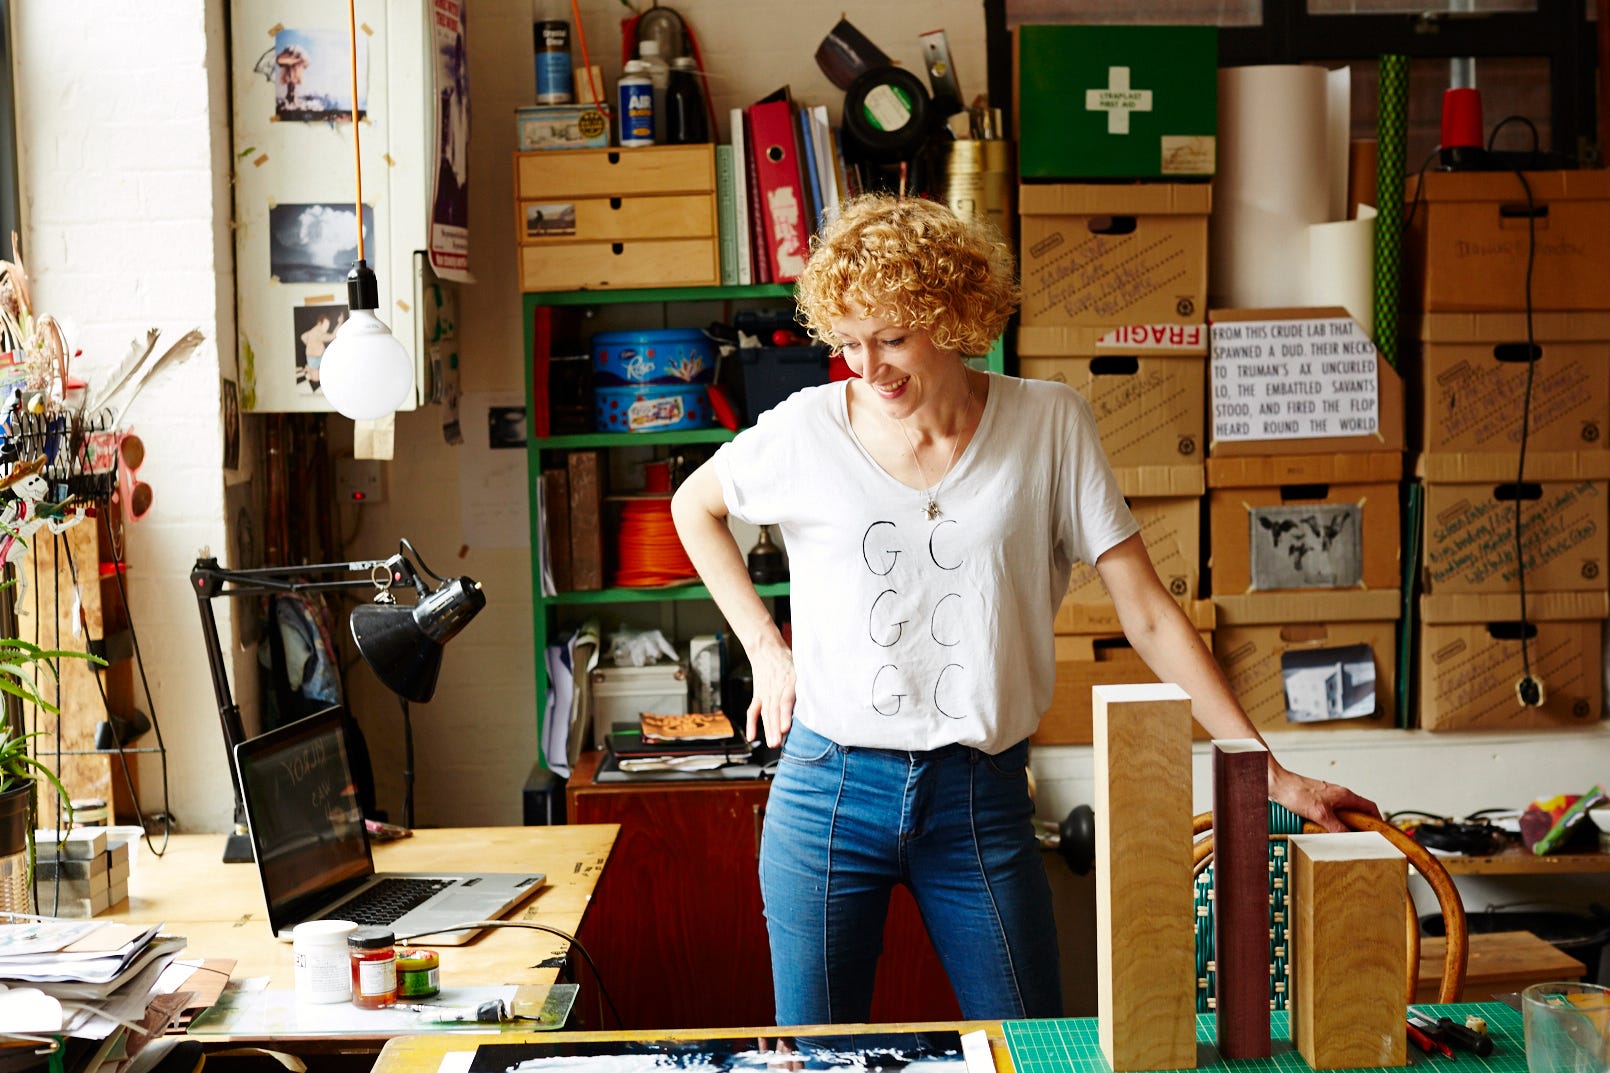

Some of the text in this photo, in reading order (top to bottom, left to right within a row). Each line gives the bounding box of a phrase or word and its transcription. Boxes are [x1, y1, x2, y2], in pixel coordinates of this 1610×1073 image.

[1213, 322, 1353, 341] FROM THIS CRUDE LAB THAT
[1213, 346, 1262, 360] SPAWNED
[1268, 346, 1275, 357] A
[1311, 343, 1339, 356] THEIR
[1342, 341, 1376, 354] NECKS
[1215, 361, 1375, 379] TO TRUMAN'S AX UNCURLED
[1215, 380, 1375, 400] LO, THE EMBATTLED SAVANTS
[1215, 399, 1375, 418] STOOD, AND FIRED THE FLOP
[1216, 418, 1376, 436] HEARD ROUND THE WORLD
[863, 519, 963, 576] G C
[869, 589, 962, 647] G C
[872, 663, 967, 719] G C
